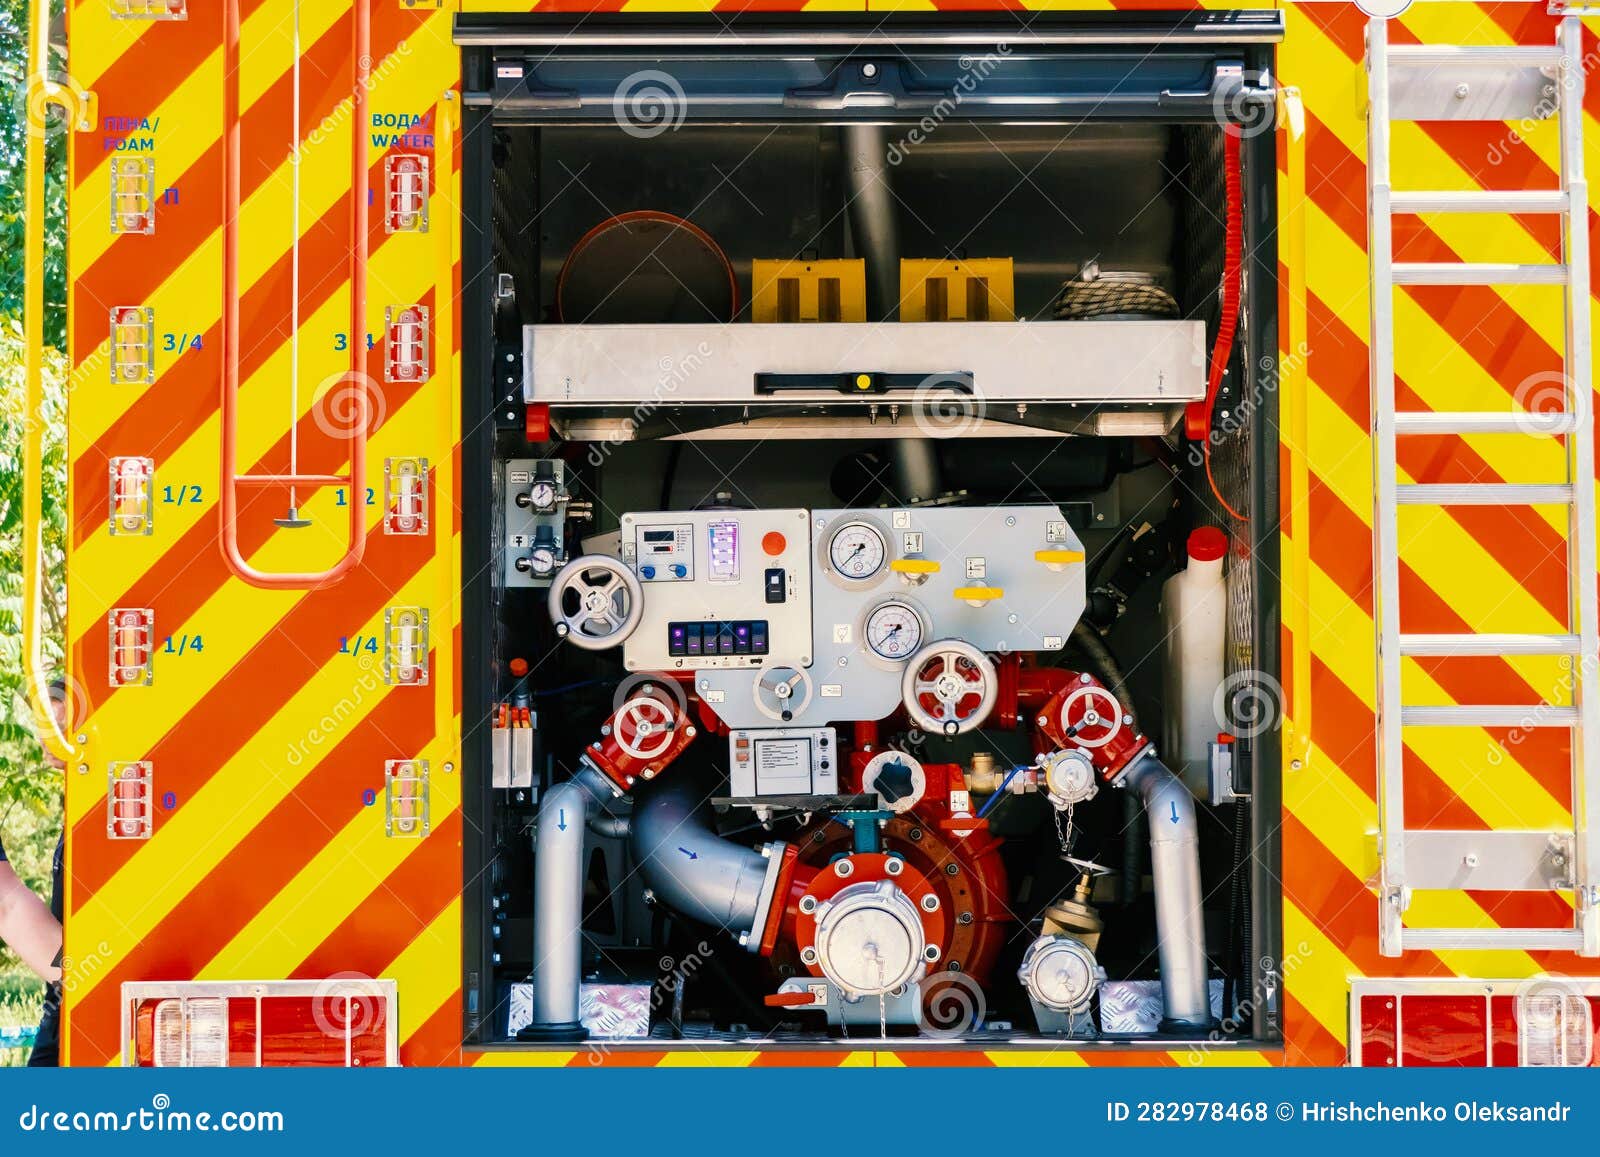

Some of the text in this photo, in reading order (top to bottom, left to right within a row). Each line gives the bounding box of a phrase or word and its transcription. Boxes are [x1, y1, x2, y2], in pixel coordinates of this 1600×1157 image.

[372, 113, 431, 129] ВОДА/
[104, 138, 154, 151] FOAM
[372, 134, 434, 148] WATER
[164, 187, 179, 205] П
[163, 333, 203, 354] 3/4
[334, 333, 375, 351] 34
[163, 485, 203, 506] 1/2
[335, 488, 375, 506] 12
[164, 635, 204, 656] 1/4
[338, 636, 379, 656] 1/4
[163, 791, 176, 810] 0
[362, 788, 376, 806] 0
